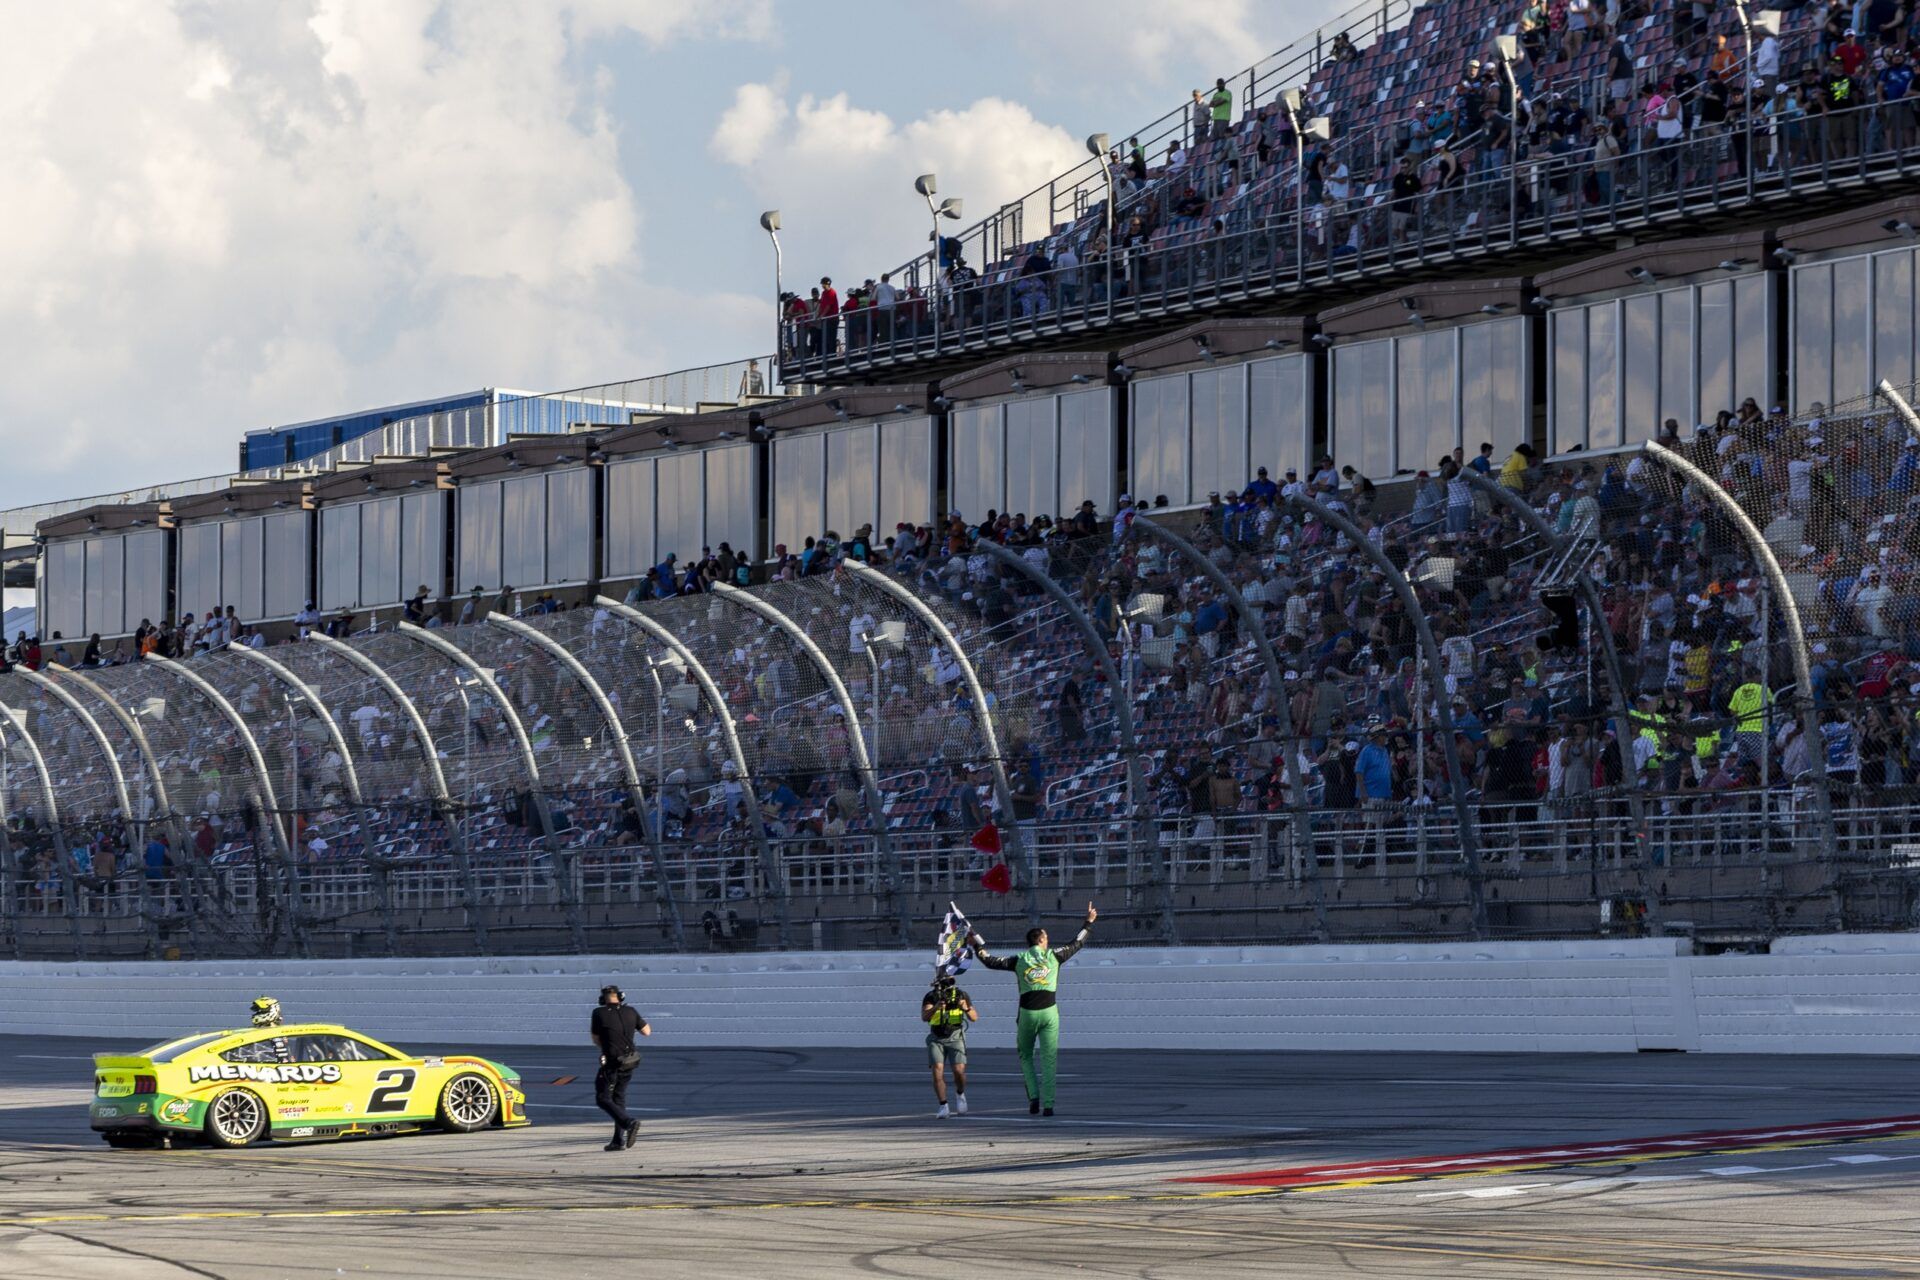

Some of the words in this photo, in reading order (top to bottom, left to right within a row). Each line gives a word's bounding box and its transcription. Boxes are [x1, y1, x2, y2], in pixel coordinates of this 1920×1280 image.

[188, 1065, 342, 1084] MENARDS
[365, 1068, 416, 1113] 2
[98, 1107, 117, 1117] FORD
[138, 1103, 148, 1113] 2
